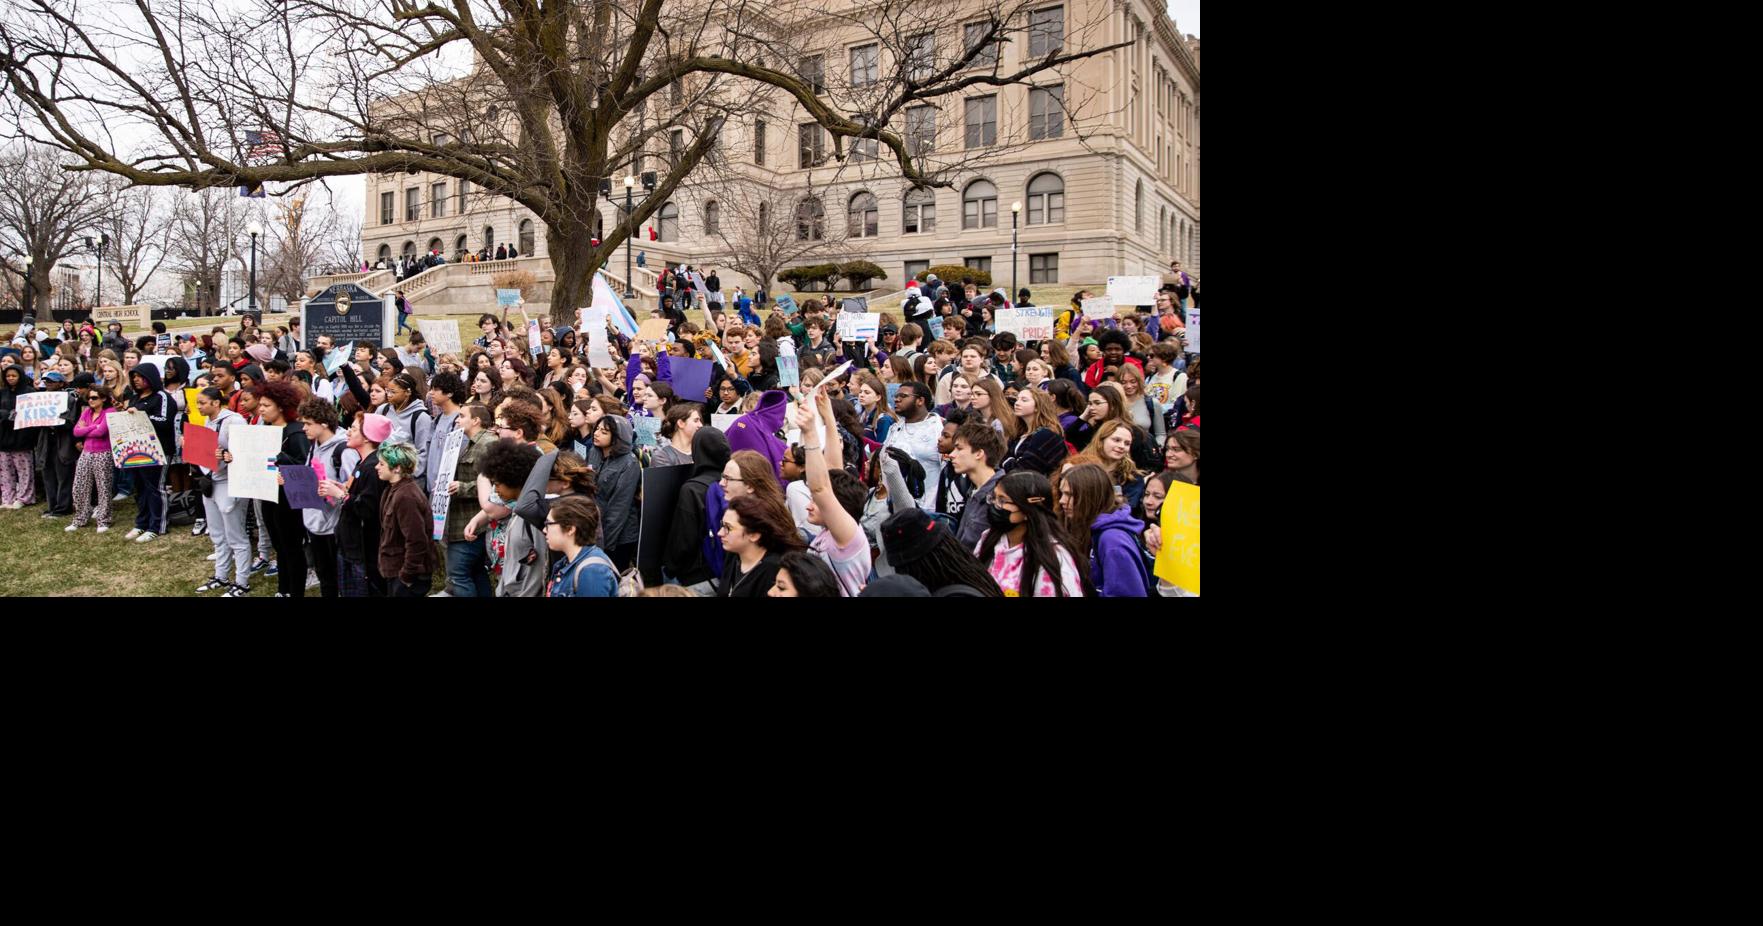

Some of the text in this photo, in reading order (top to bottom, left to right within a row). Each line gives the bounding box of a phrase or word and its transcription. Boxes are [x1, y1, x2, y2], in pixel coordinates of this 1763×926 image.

[324, 314, 363, 323] CAPITOL HILL
[1022, 327, 1049, 339] PRIDE
[24, 406, 57, 420] KIDS
